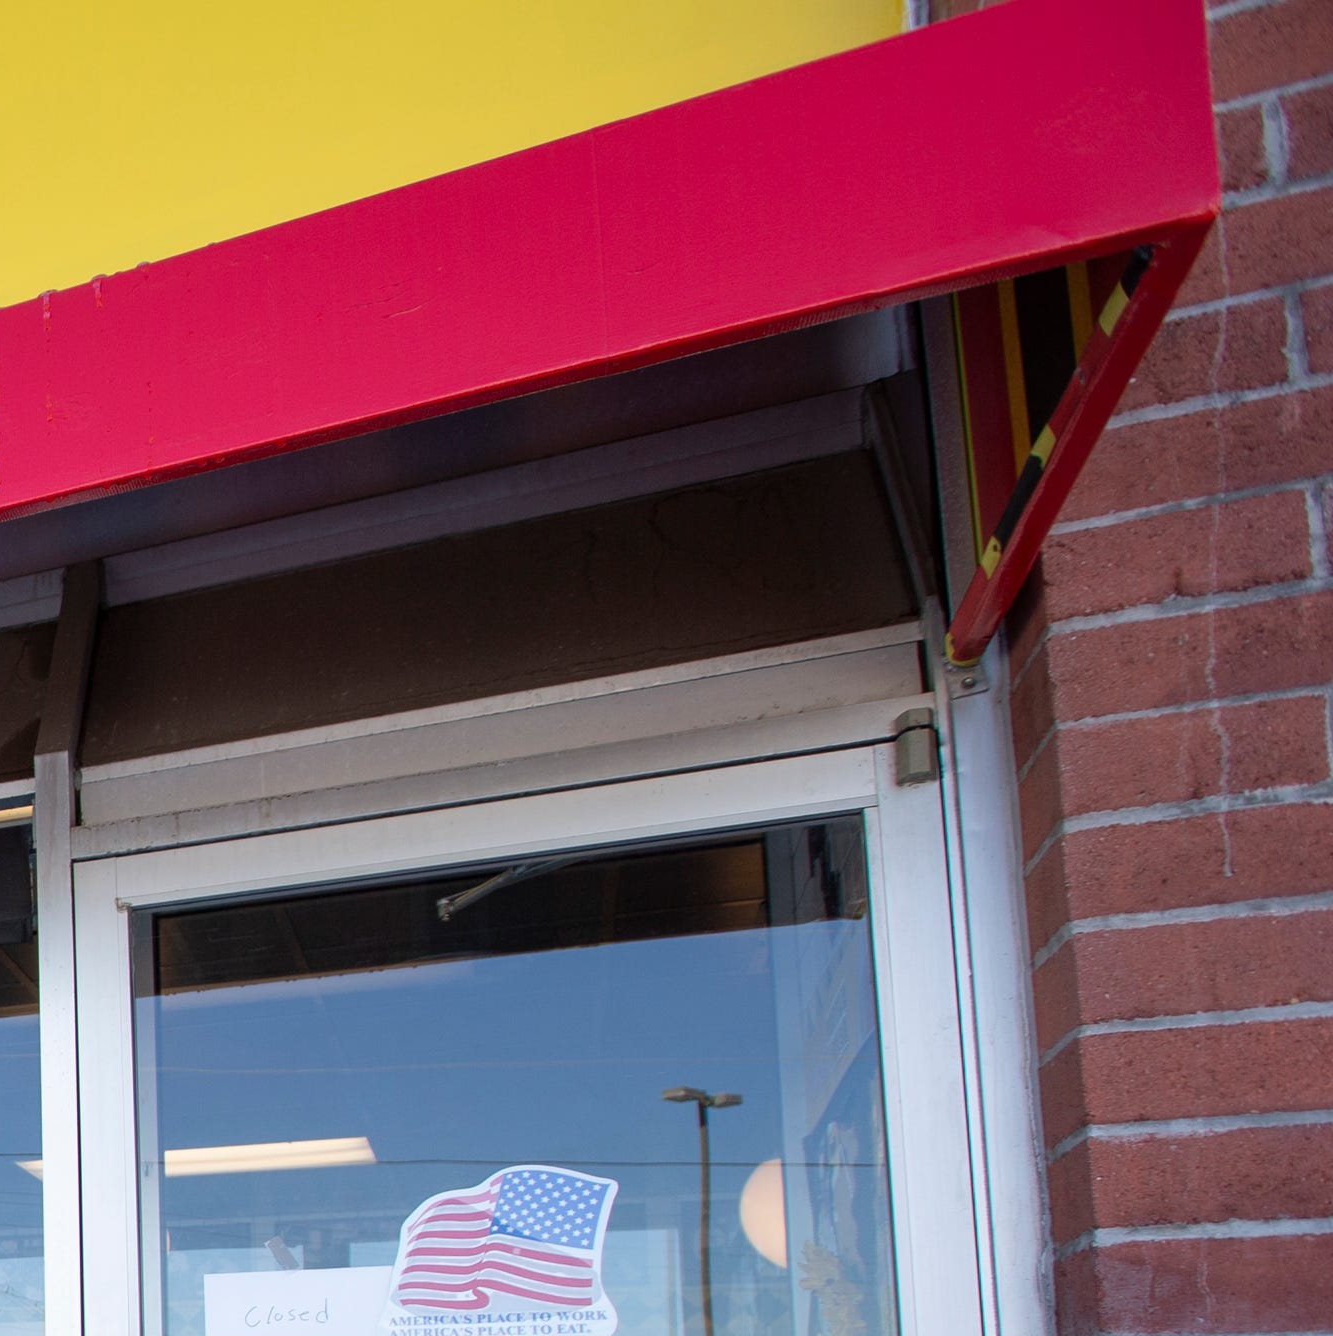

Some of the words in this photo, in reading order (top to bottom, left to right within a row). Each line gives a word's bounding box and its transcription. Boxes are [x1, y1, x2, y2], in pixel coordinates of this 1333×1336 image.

[244, 1298, 331, 1328] Closed
[389, 1312, 473, 1327] AMERICA'S
[476, 1312, 525, 1324] PLACE
[530, 1311, 551, 1322] TO
[555, 1310, 608, 1322] WORK
[476, 1325, 528, 1336] PLACE
[531, 1324, 553, 1335] TO
